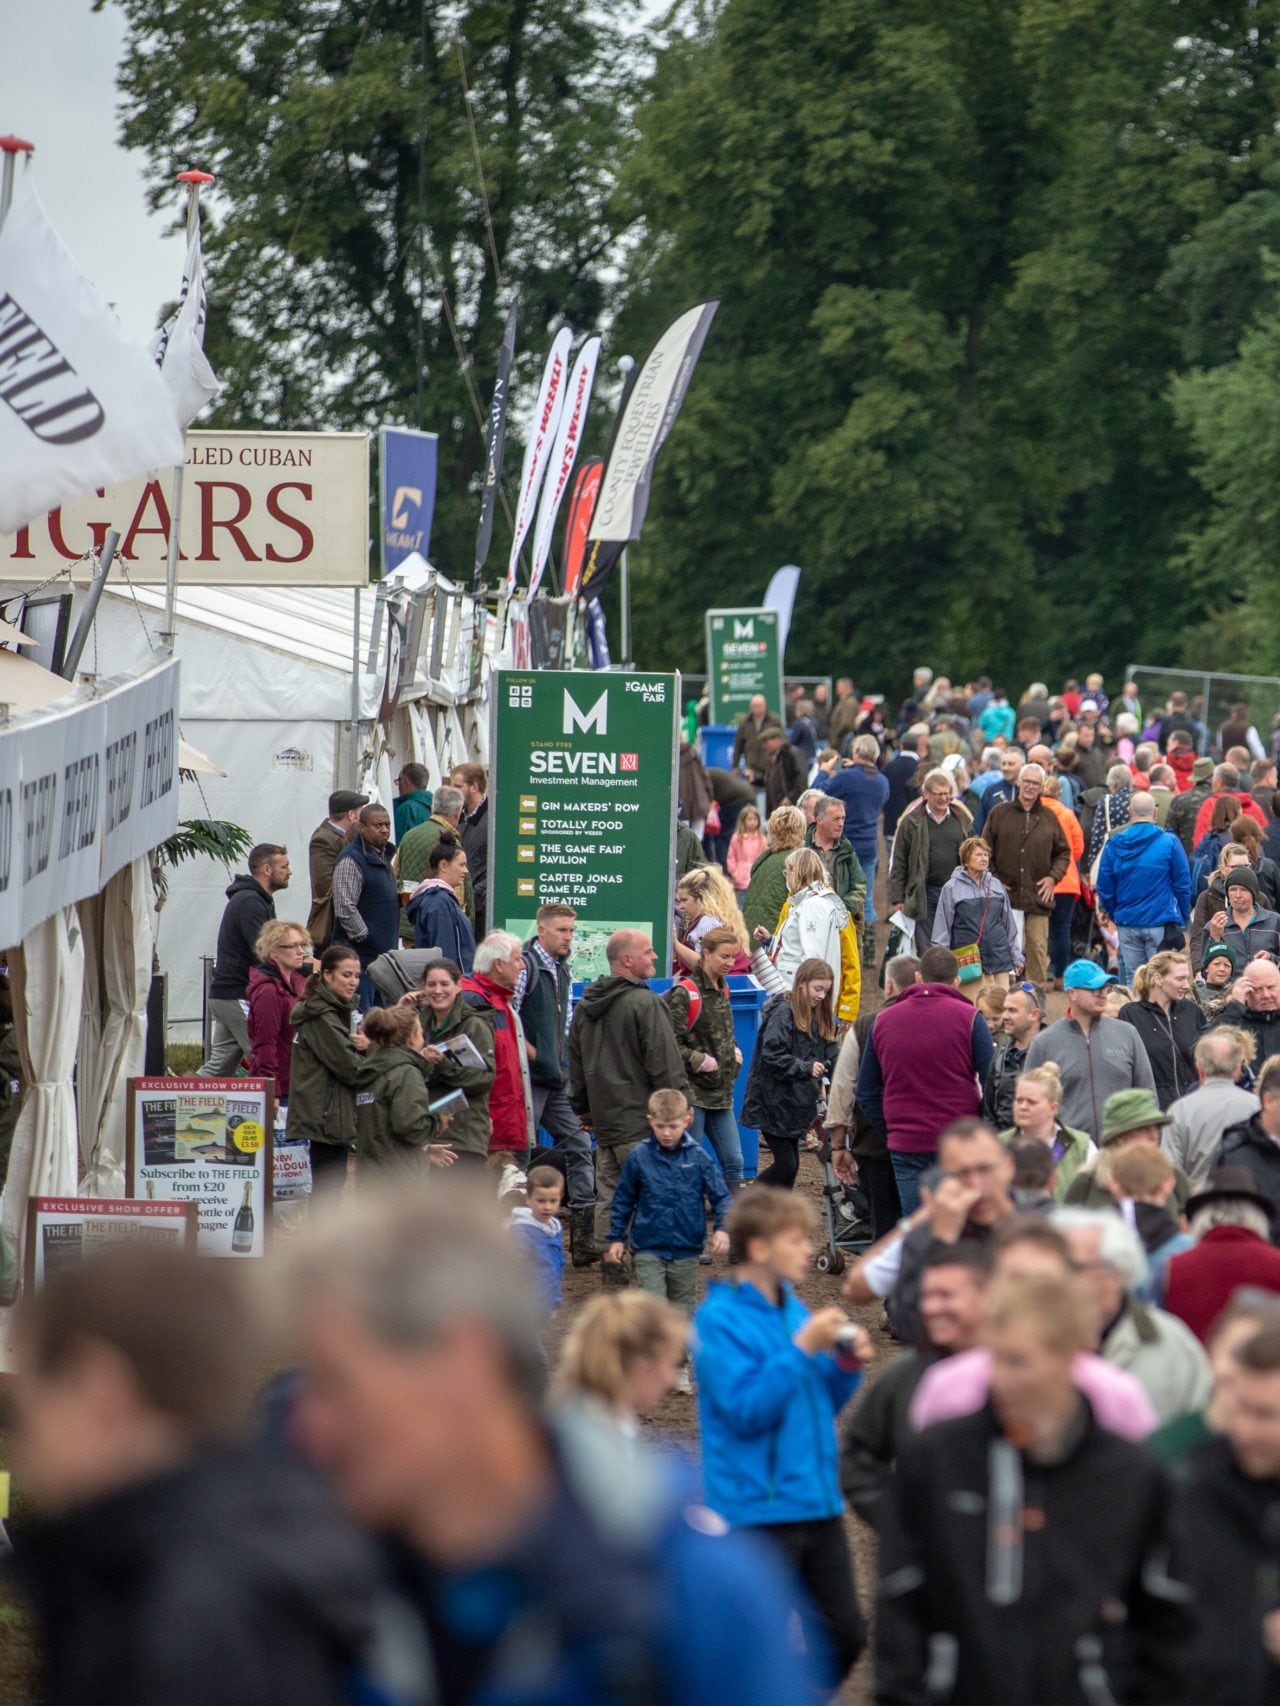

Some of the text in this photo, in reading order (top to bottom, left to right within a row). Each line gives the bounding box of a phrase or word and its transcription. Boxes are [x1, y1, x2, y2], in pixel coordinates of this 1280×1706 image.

[0, 292, 105, 445] IELD
[540, 353, 563, 434] WEEKLY
[621, 352, 664, 451] EQUESTRIAN
[624, 402, 661, 483] JEWELLERS
[239, 447, 312, 466] CUBAN
[10, 479, 315, 563] IGARS
[734, 617, 755, 640] M
[631, 681, 665, 693] GAME
[643, 693, 665, 703] FAIR
[563, 687, 608, 735] M
[529, 751, 617, 774] SEVEN
[529, 775, 638, 788] Investment Management
[541, 802, 561, 812] GIN
[615, 803, 640, 813] ROW
[541, 819, 623, 830] TOTALLY FOOD
[541, 843, 561, 853] THE
[565, 844, 596, 854] GAME
[540, 855, 587, 865] PAVILION
[539, 873, 623, 884] CARTER JONAS
[539, 884, 597, 894] GAME FAIR
[539, 896, 588, 906] THEATRE
[144, 1101, 176, 1112] THE FIE
[178, 1096, 225, 1107] THE FIELD
[232, 1104, 259, 1114] FIELD
[273, 1161, 308, 1170] ALOGUE
[140, 1168, 259, 1179] Subscribe to THE FIELD
[172, 1182, 200, 1192] from
[192, 1196, 228, 1205] receive
[43, 1203, 181, 1214] EXCLUSIVE SHOW OFFER
[225, 1208, 236, 1217] of
[45, 1225, 83, 1237] THE FIE
[86, 1221, 138, 1233] THE FIELD
[198, 1221, 228, 1232] pagne
